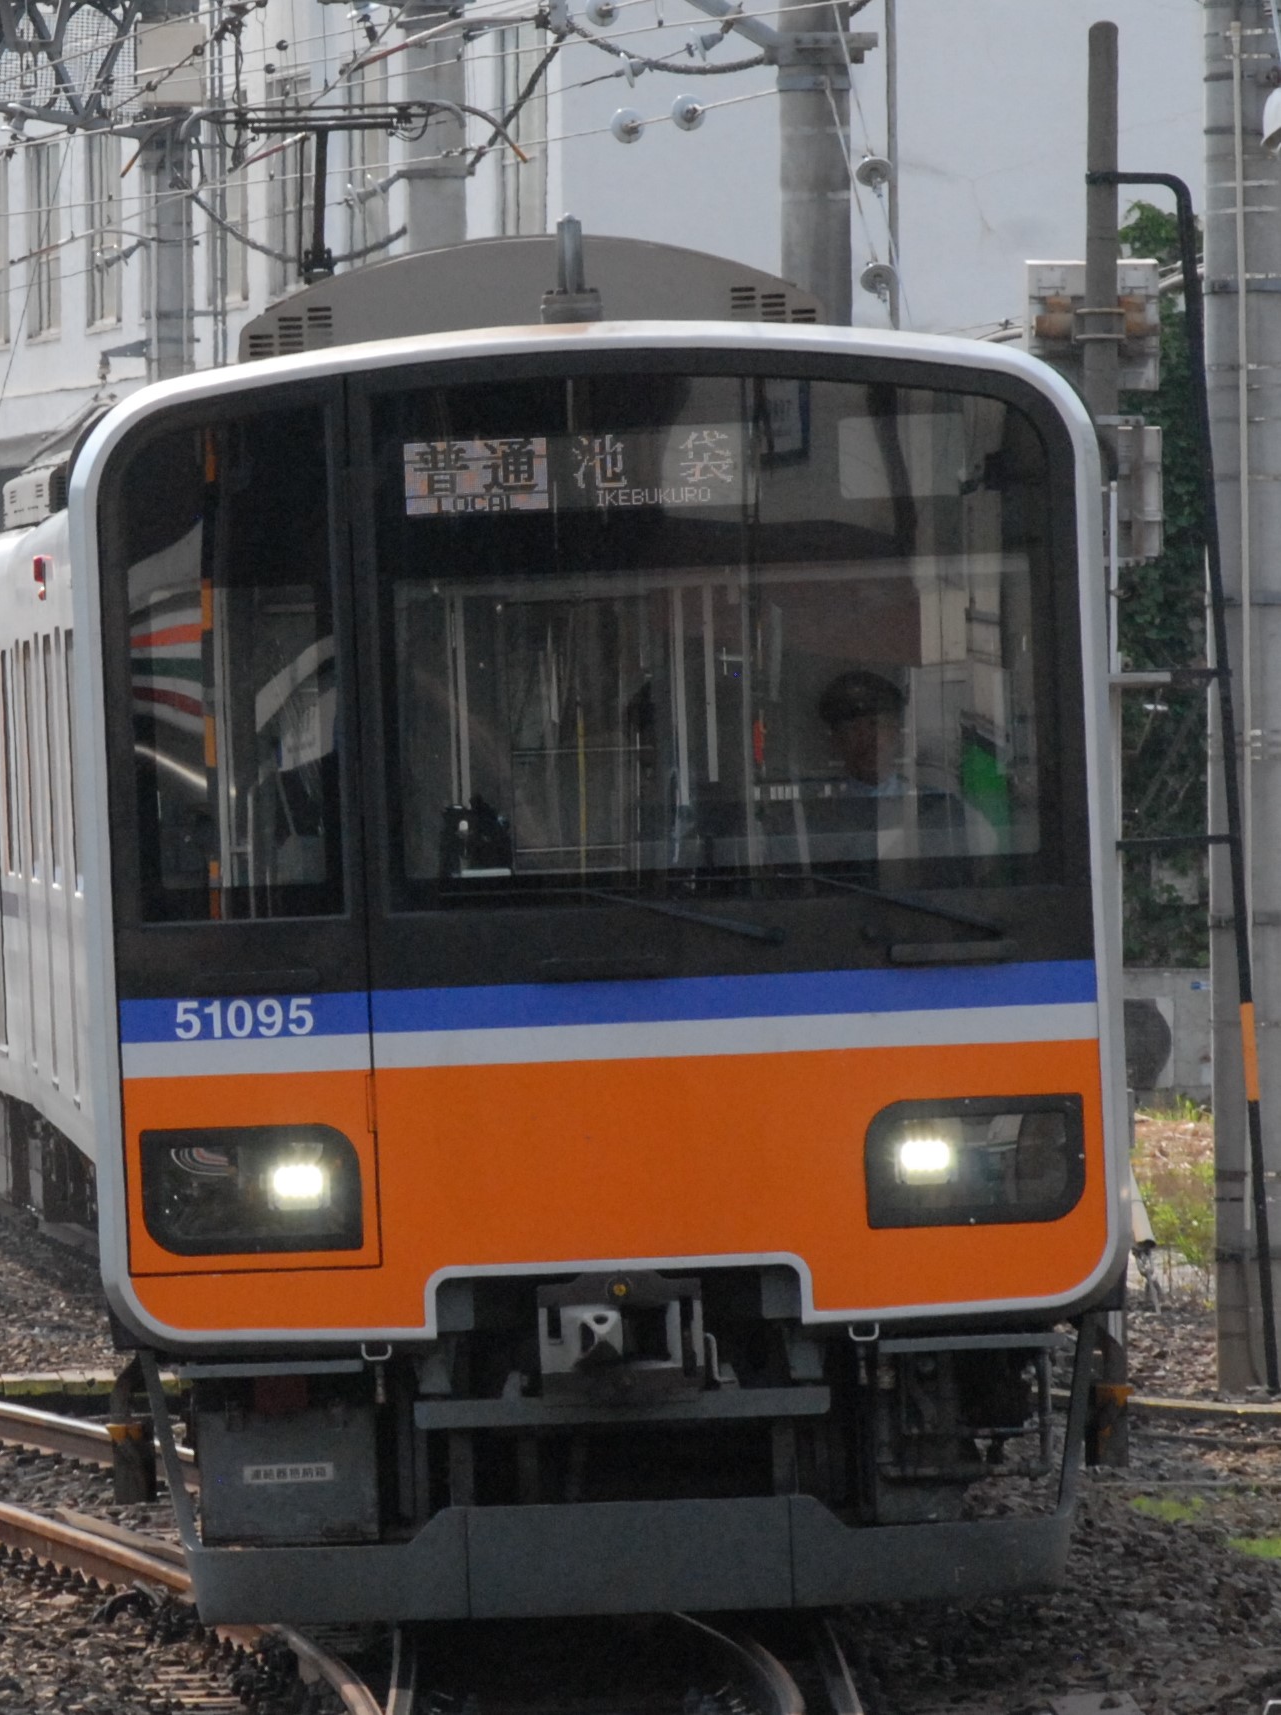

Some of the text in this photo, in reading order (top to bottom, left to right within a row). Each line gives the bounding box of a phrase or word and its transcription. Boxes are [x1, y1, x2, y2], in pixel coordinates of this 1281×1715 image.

[413, 440, 539, 495] 普通
[572, 430, 735, 489] 池袋
[596, 486, 711, 507] IKEBUKURO
[175, 997, 314, 1040] 51095
